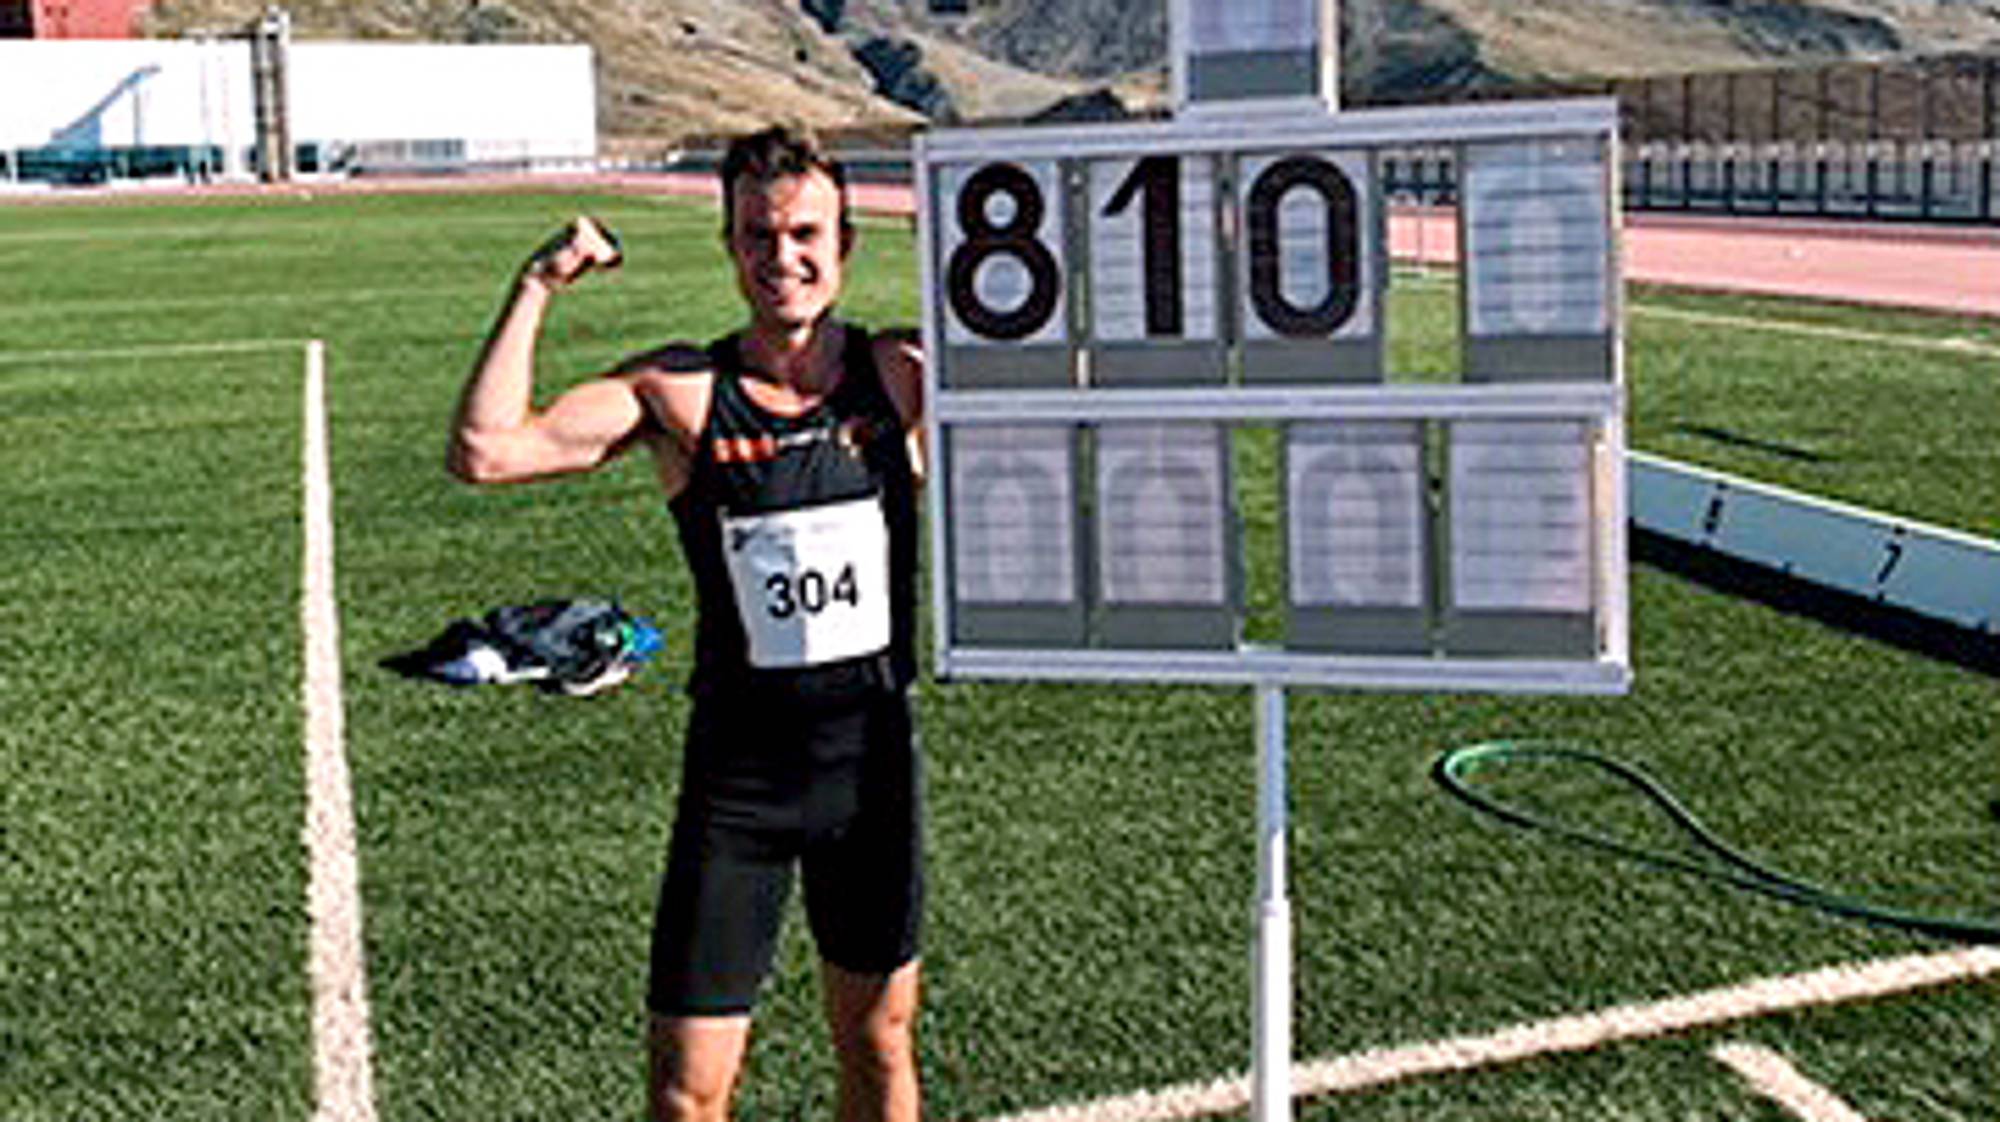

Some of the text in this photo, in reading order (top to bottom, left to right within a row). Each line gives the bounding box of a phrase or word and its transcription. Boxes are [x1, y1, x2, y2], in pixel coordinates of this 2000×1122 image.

[946, 154, 1359, 341] 810
[765, 563, 858, 620] 304
[1876, 542, 1903, 584] 7
